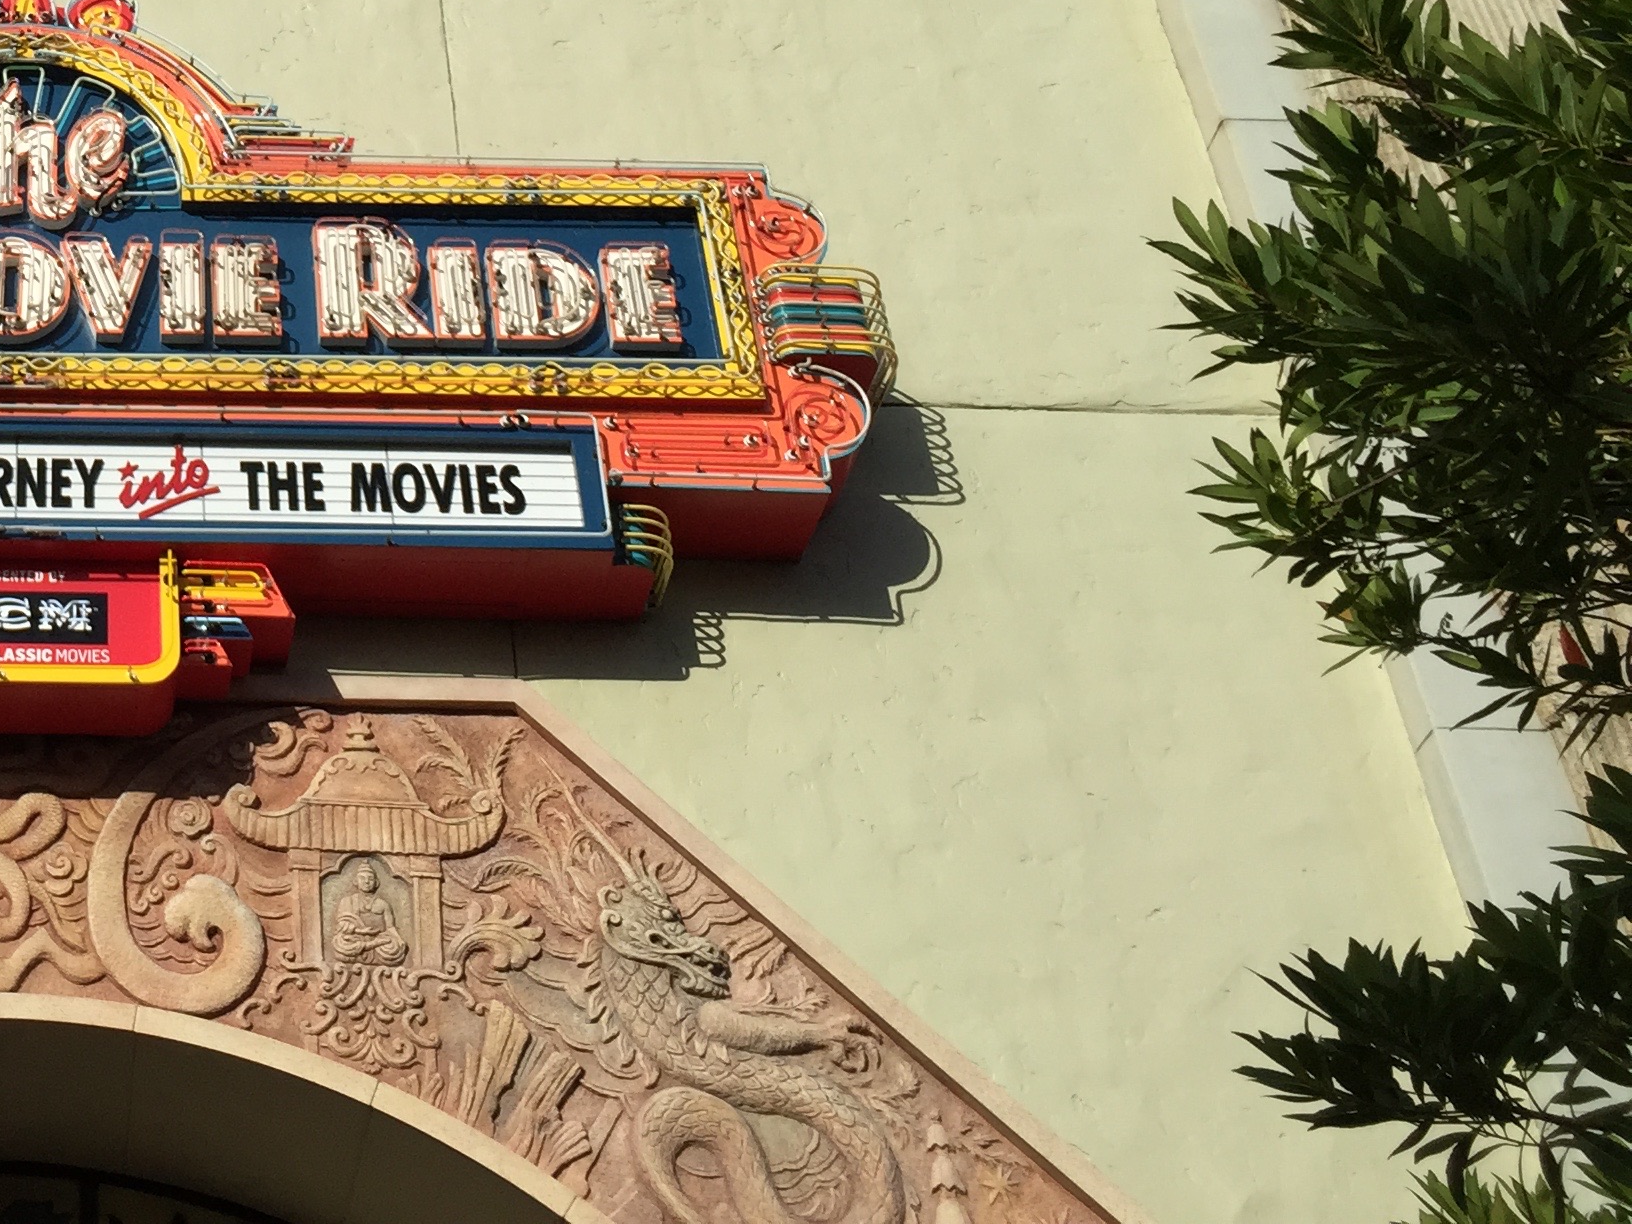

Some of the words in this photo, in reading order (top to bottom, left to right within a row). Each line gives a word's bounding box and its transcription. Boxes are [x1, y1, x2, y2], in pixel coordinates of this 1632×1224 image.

[312, 217, 682, 352] RIDE
[118, 444, 218, 518] into
[239, 461, 325, 511] THE
[351, 462, 526, 515] MOVIES
[55, 649, 110, 663] MOVIES
